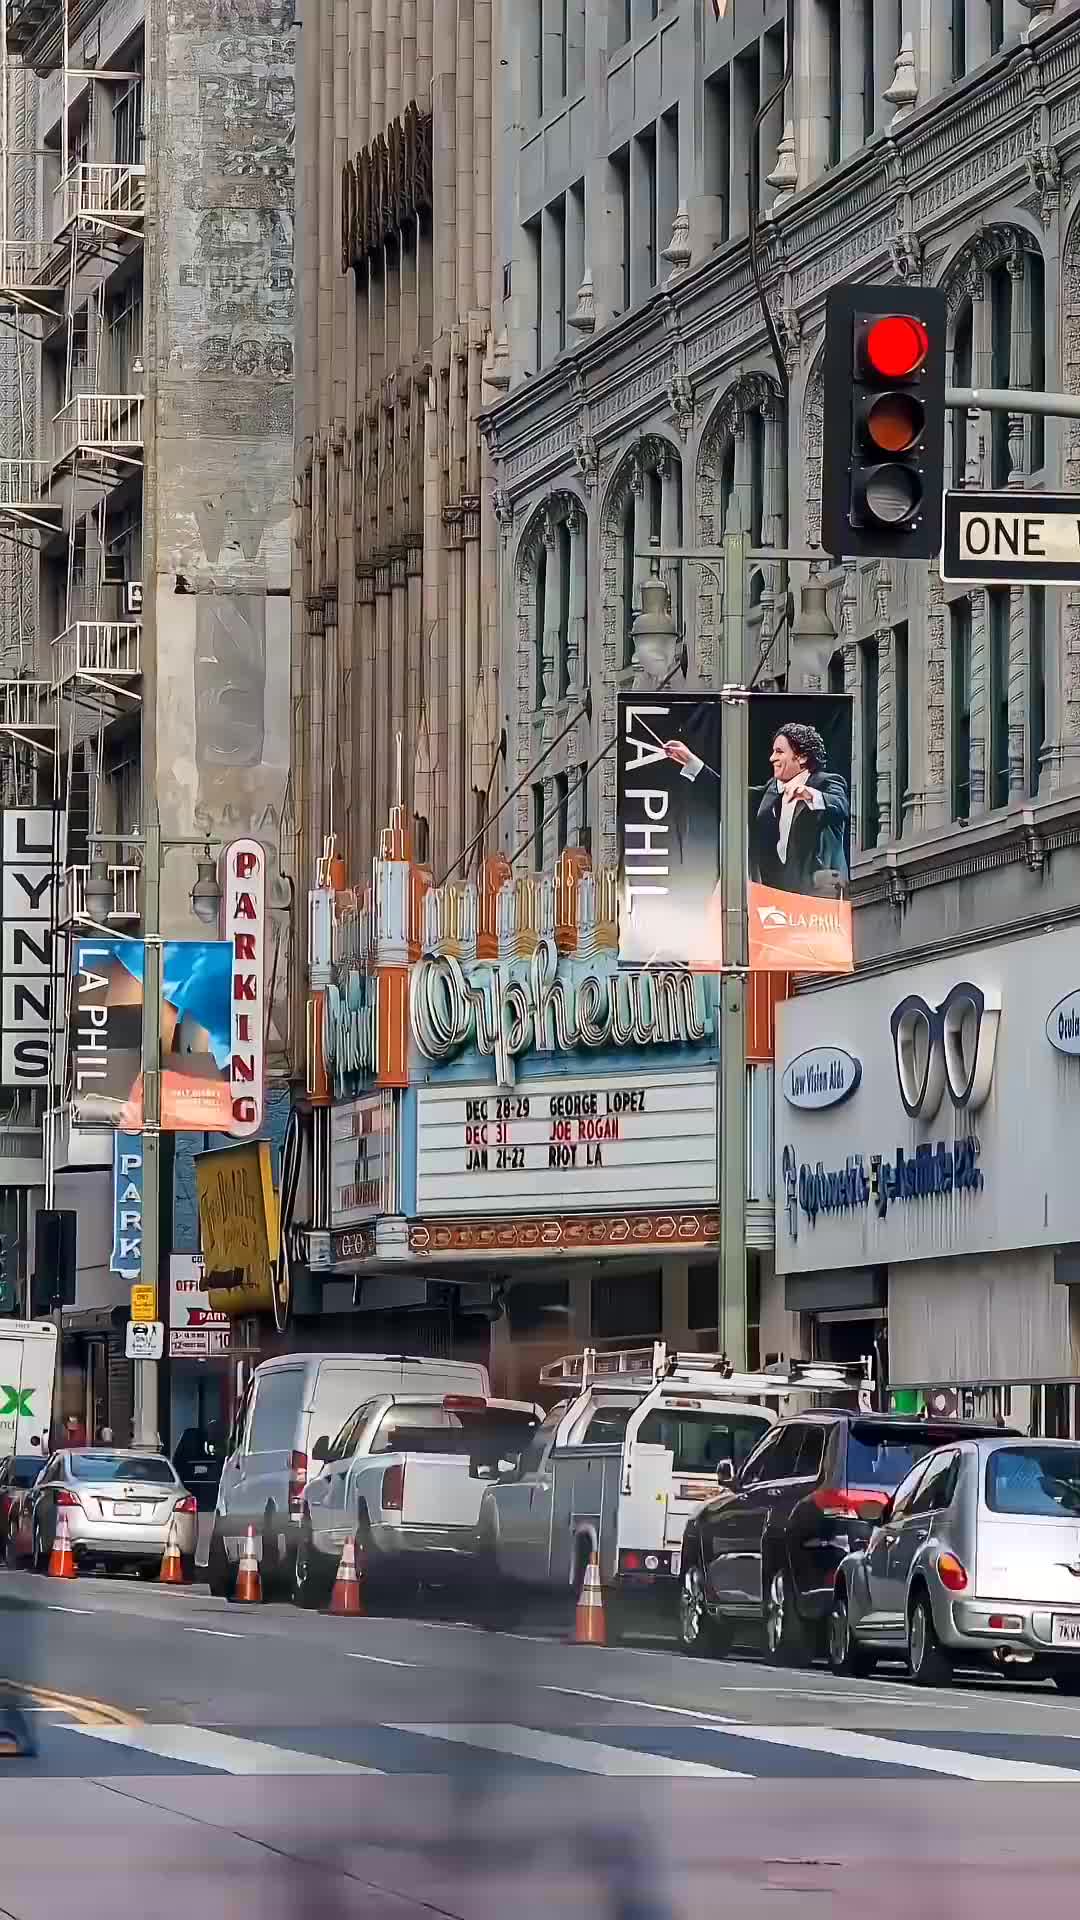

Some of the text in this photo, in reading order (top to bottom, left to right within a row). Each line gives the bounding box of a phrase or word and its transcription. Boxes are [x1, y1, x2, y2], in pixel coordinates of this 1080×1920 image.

[966, 517, 1046, 556] ONE
[625, 706, 670, 913] LA PHIL
[12, 817, 55, 1078] LYNNS
[232, 851, 257, 1122] PARKING
[77, 948, 109, 1090] LA PHIL
[409, 940, 706, 1088] Orpheum
[466, 1090, 645, 1121] DEC 28-29 GEORGE LOPEZ
[466, 1116, 619, 1145] DEC 31 JOE ROGAN
[466, 1148, 488, 1171] JAN
[496, 1147, 525, 1168] 21-22
[587, 1143, 602, 1168] LA
[120, 1154, 143, 1259] PARK
